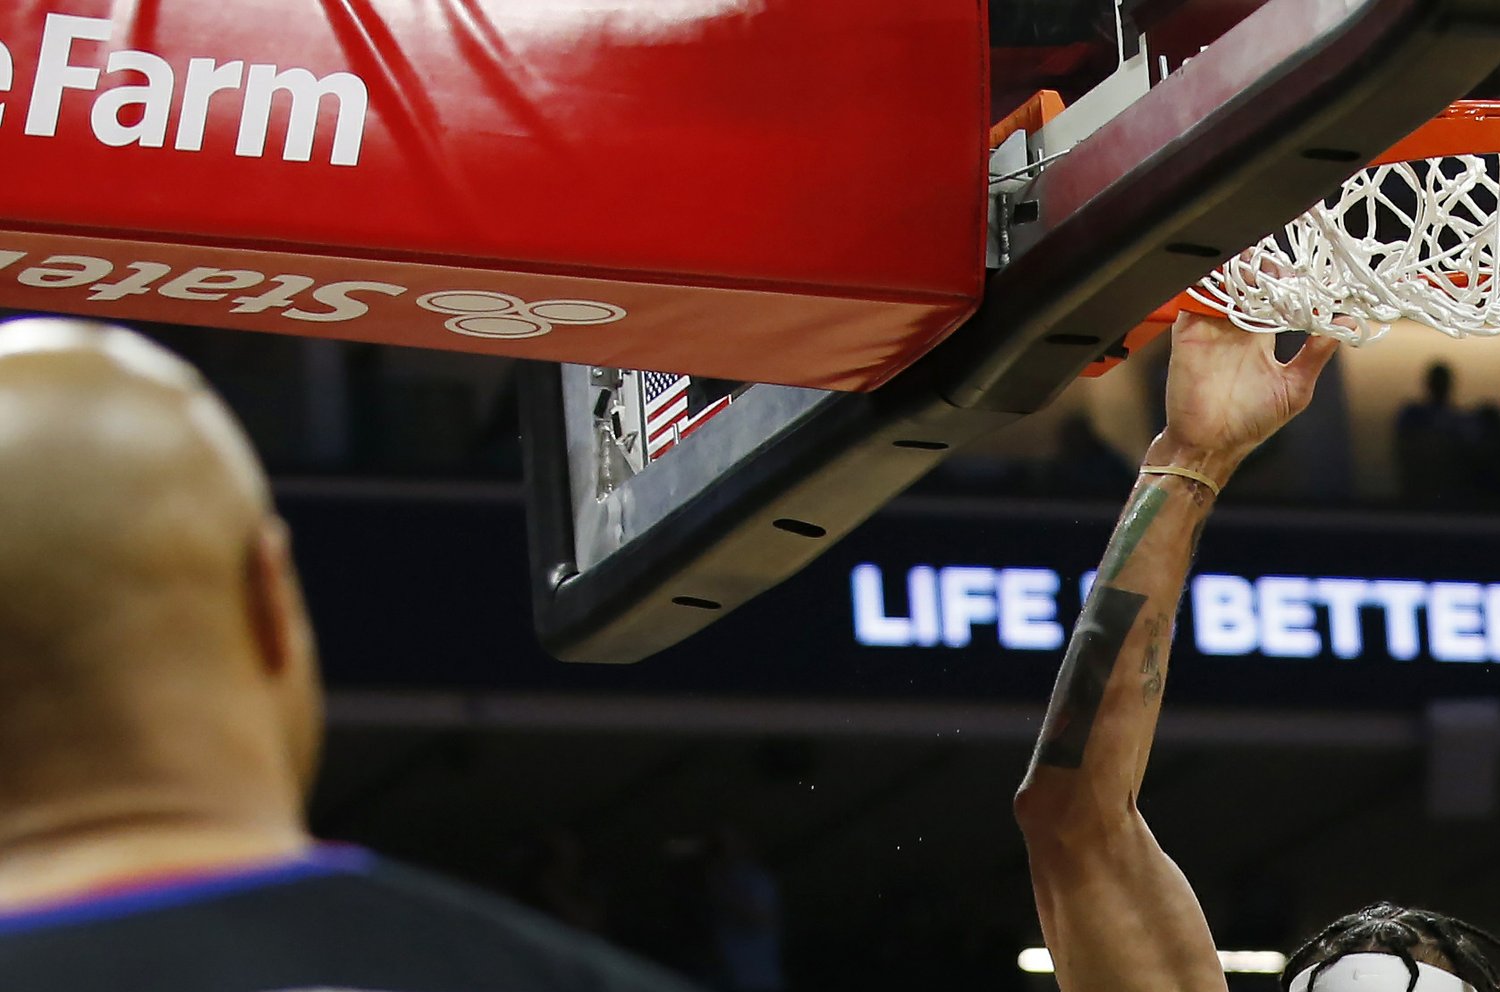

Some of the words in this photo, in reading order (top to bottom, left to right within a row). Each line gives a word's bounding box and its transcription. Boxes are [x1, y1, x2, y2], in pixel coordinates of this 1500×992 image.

[24, 13, 369, 166] Farm
[18, 254, 407, 322] State
[851, 563, 1063, 651] LIFE
